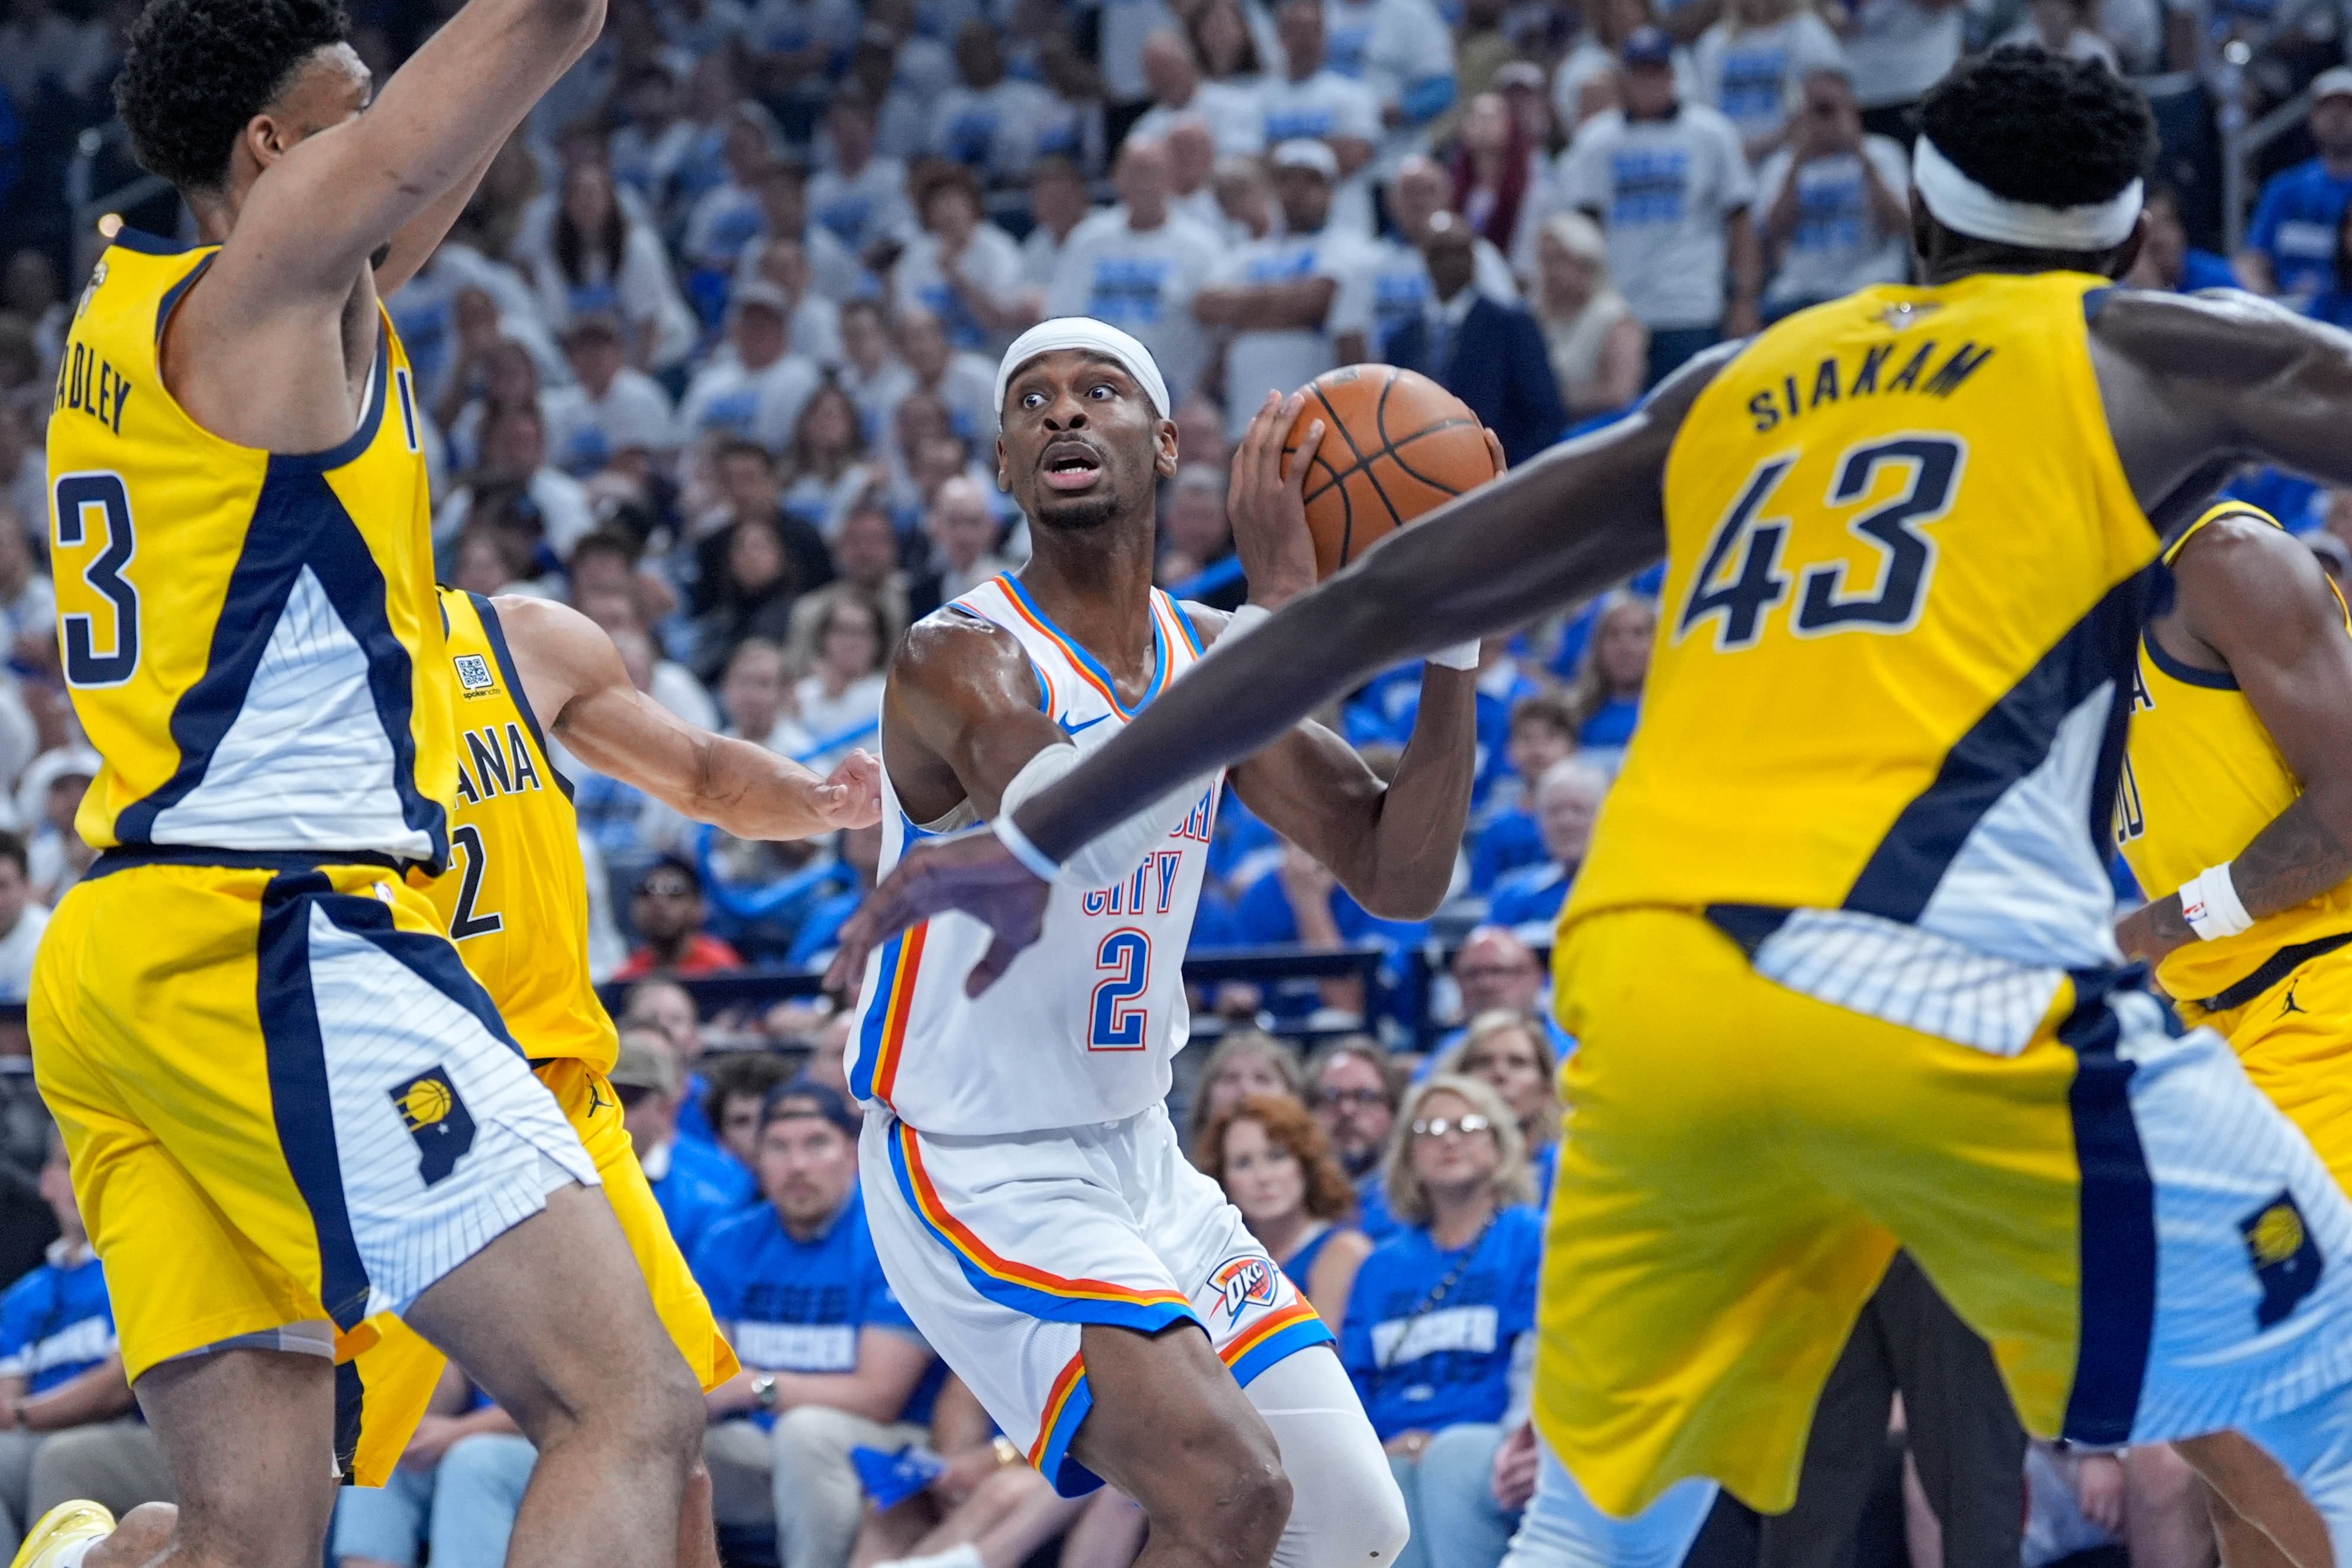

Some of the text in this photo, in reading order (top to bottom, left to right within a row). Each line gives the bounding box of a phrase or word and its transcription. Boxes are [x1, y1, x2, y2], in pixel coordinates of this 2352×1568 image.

[52, 341, 131, 435] ADLEY
[1748, 341, 1996, 431] SIAKAM
[1670, 430, 1969, 653] 43
[463, 688, 500, 699] spokenote
[1087, 927, 1152, 1051] 2
[1226, 1261, 1264, 1317] OKC
